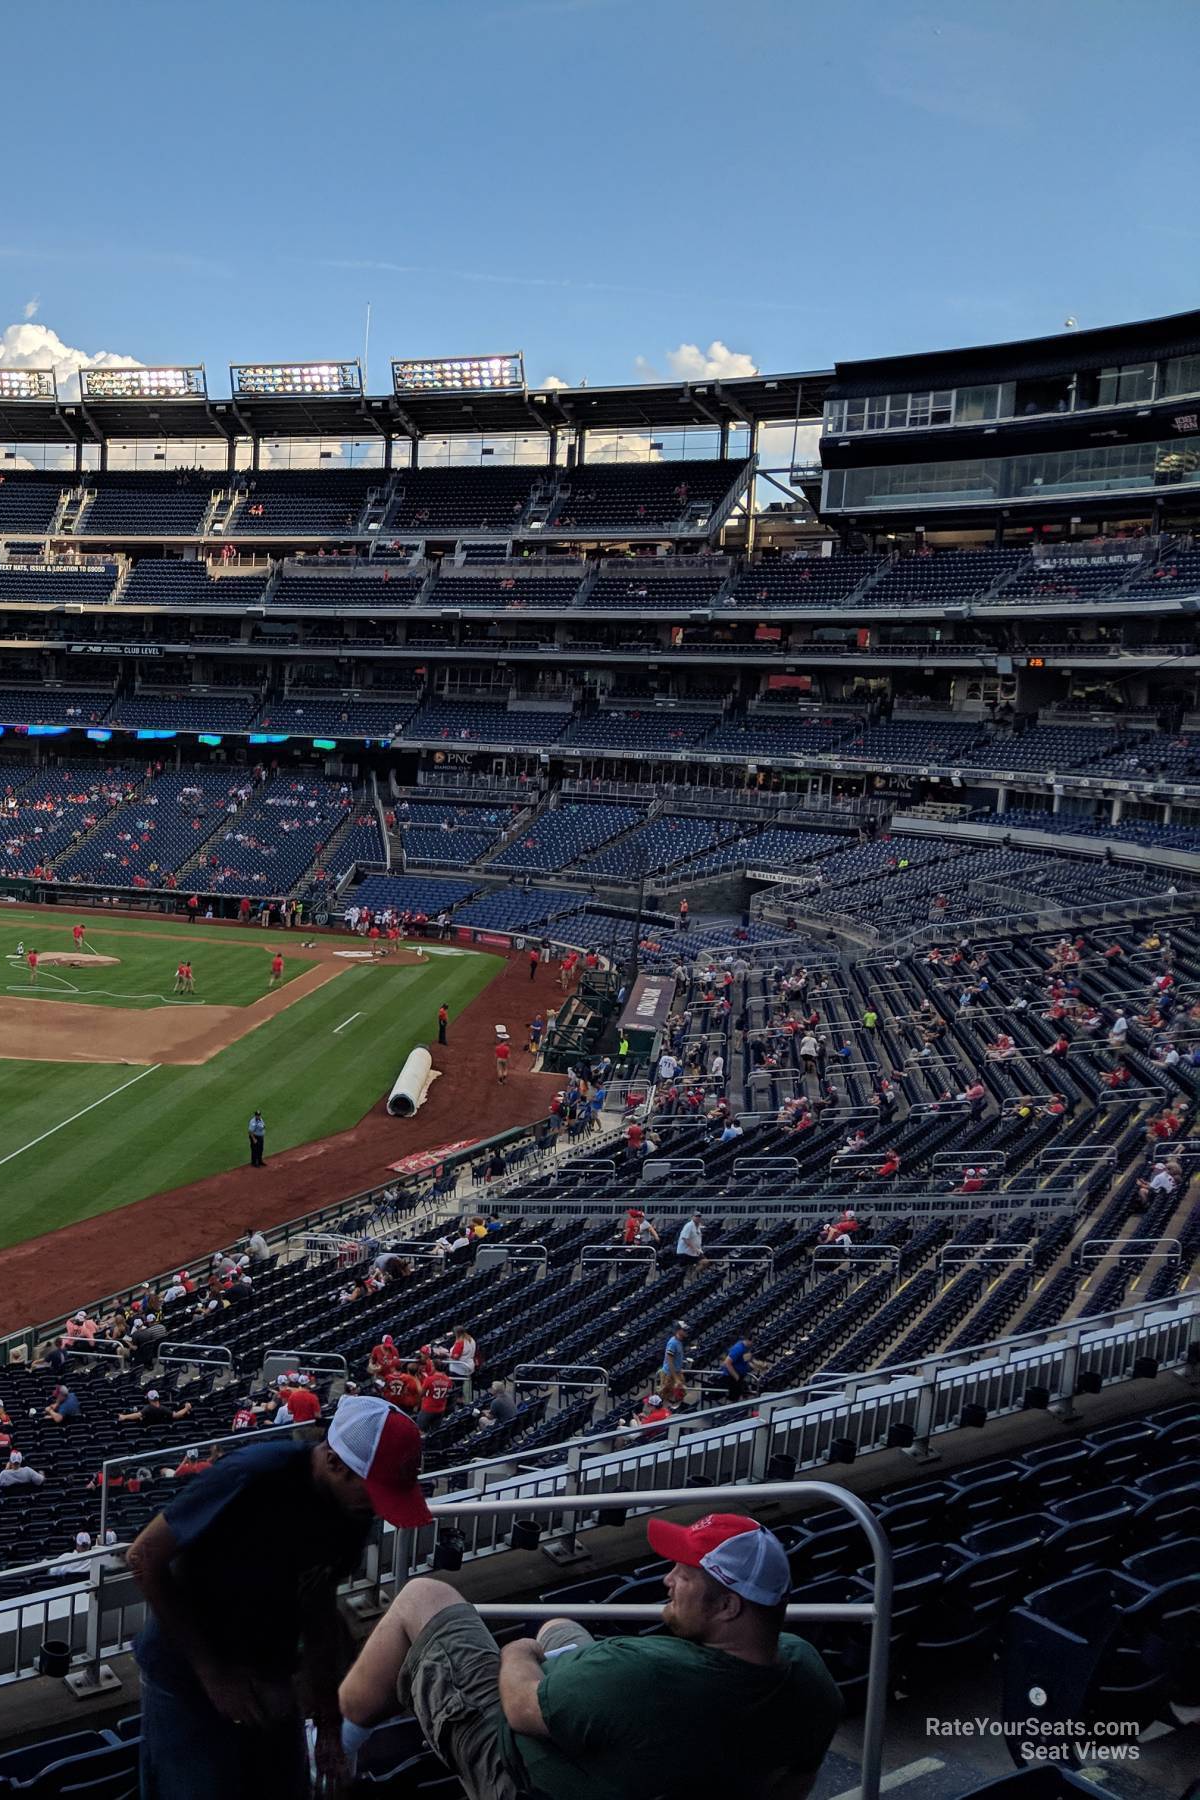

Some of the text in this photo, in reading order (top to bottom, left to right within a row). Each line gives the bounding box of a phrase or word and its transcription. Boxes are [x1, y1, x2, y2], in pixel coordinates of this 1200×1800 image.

[124, 646, 140, 654] CLUB
[141, 647, 160, 655] LEVEL
[447, 753, 473, 764] PNC
[889, 776, 913, 790] PNC
[390, 1384, 403, 1396] 37
[432, 1386, 448, 1400] 37
